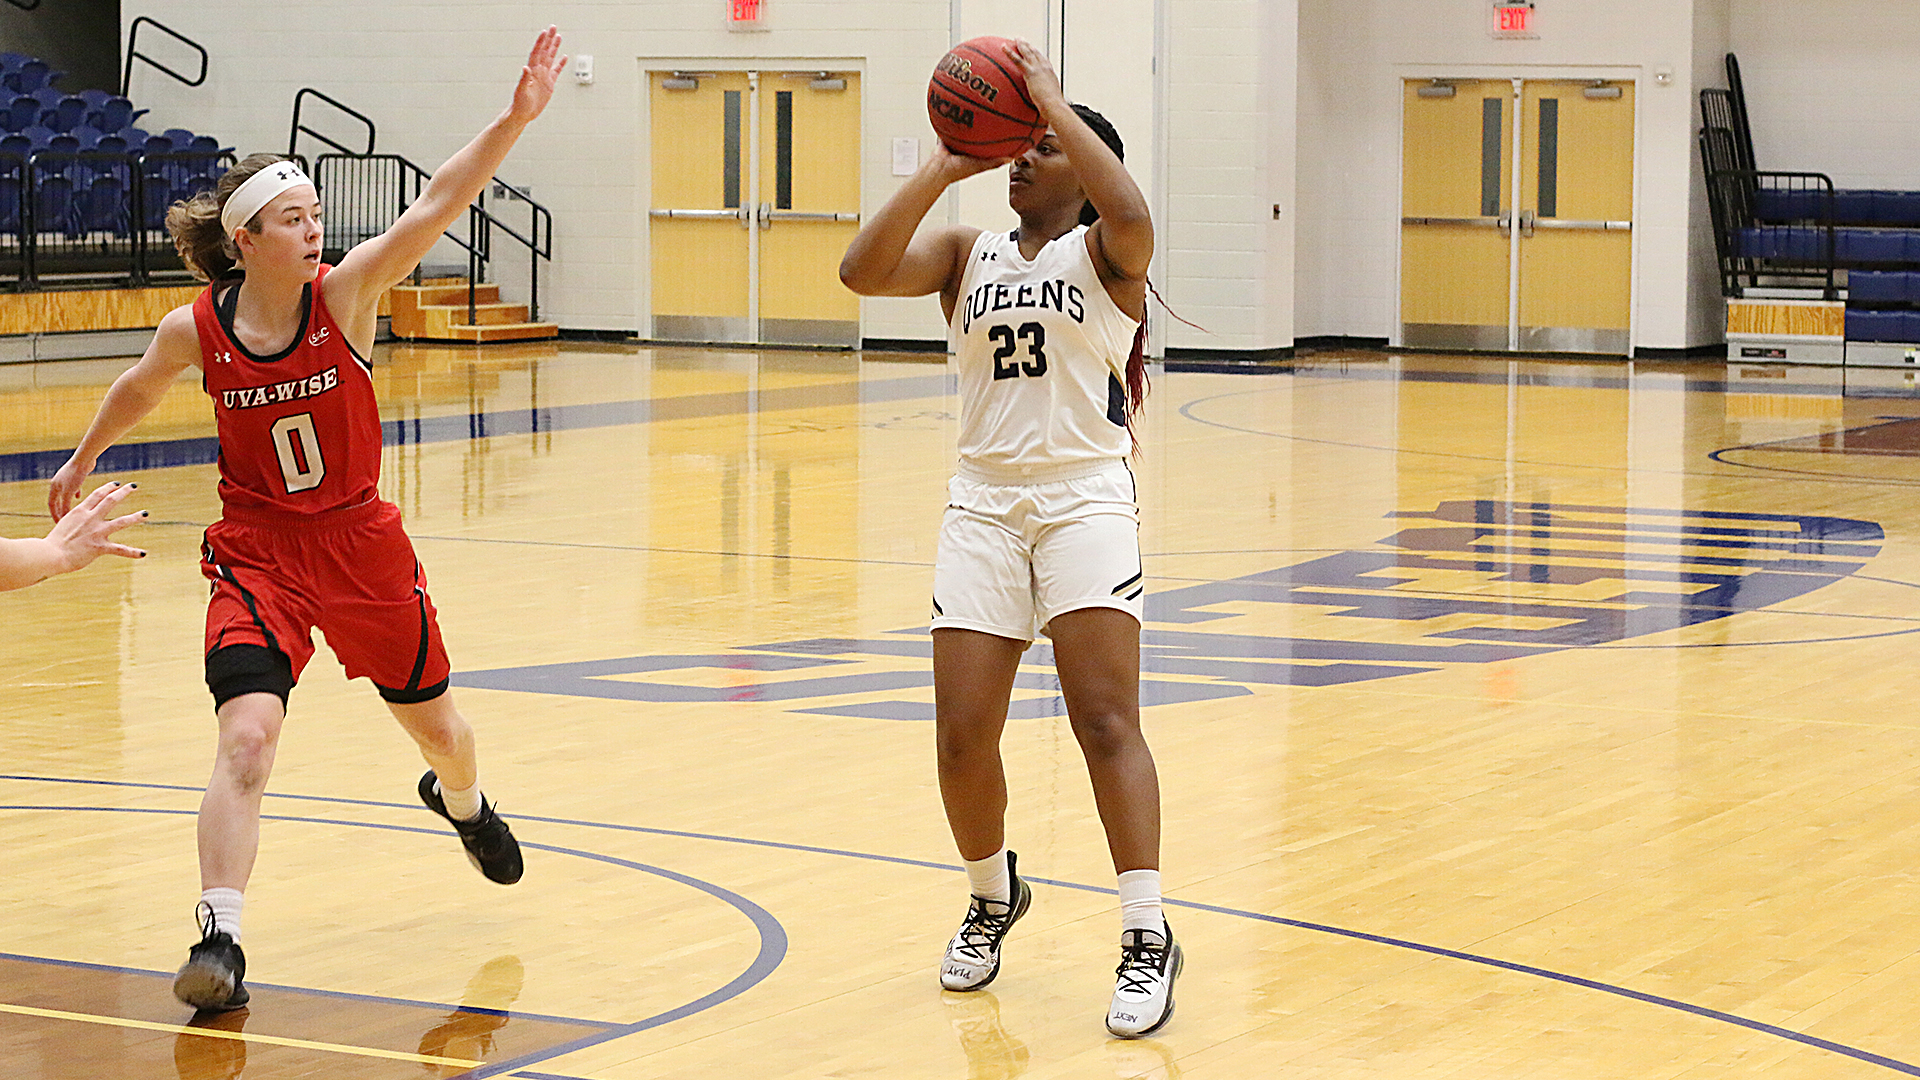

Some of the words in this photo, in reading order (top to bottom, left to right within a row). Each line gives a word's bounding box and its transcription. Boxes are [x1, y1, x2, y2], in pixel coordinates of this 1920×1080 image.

[732, 0, 759, 21] EXIT
[1500, 7, 1528, 30] EXIT
[936, 53, 999, 102] Wilson
[929, 89, 975, 128] NCAA
[963, 279, 1085, 334] QUEENS
[988, 321, 1048, 381] 23
[221, 366, 339, 410] UVA-WISE
[269, 411, 327, 495] 0
[947, 965, 971, 980] PLAY
[1112, 1011, 1139, 1023] NEXT
